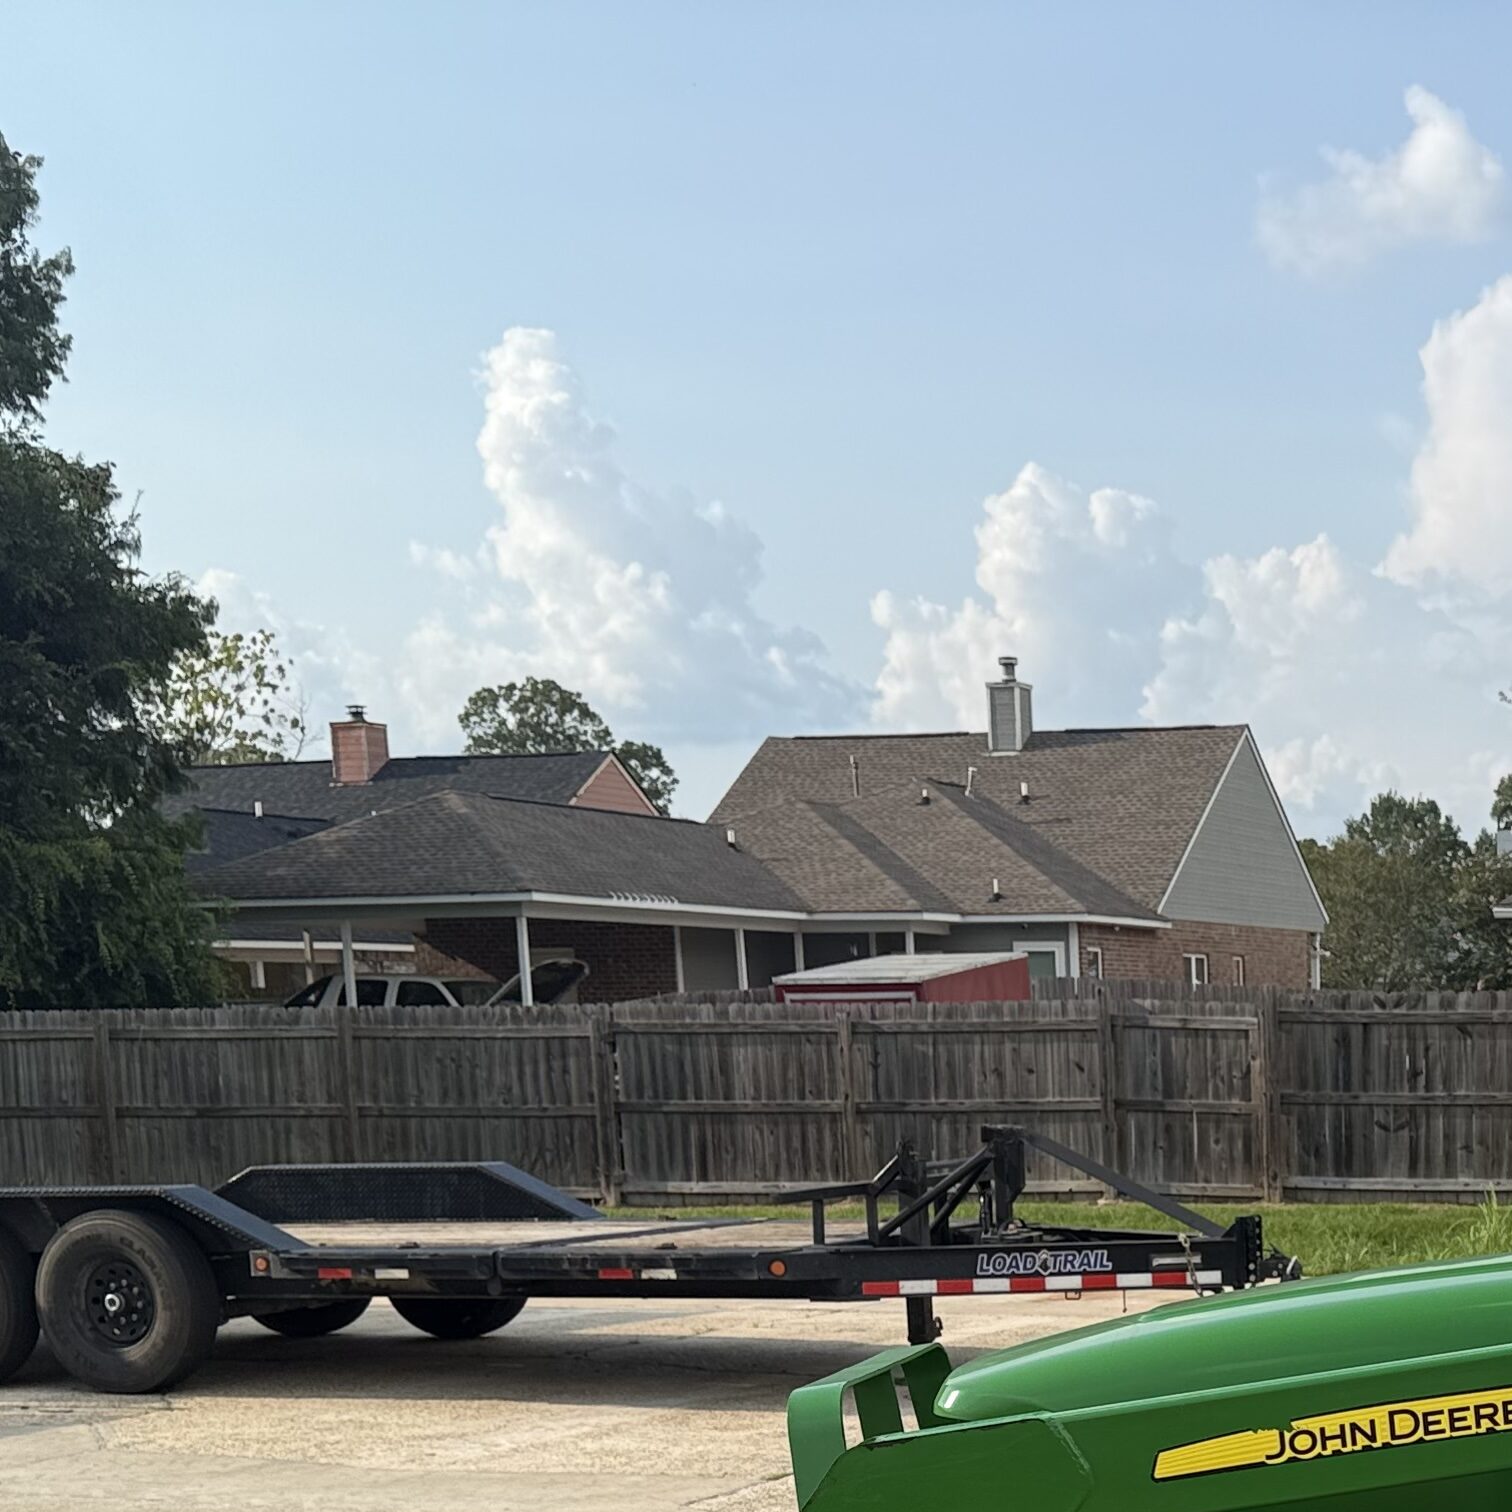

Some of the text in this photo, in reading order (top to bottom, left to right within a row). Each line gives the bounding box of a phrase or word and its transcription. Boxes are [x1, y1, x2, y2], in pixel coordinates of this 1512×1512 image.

[976, 1250, 1113, 1275] LOAD TRAIL
[1264, 1417, 1377, 1461] JOHN
